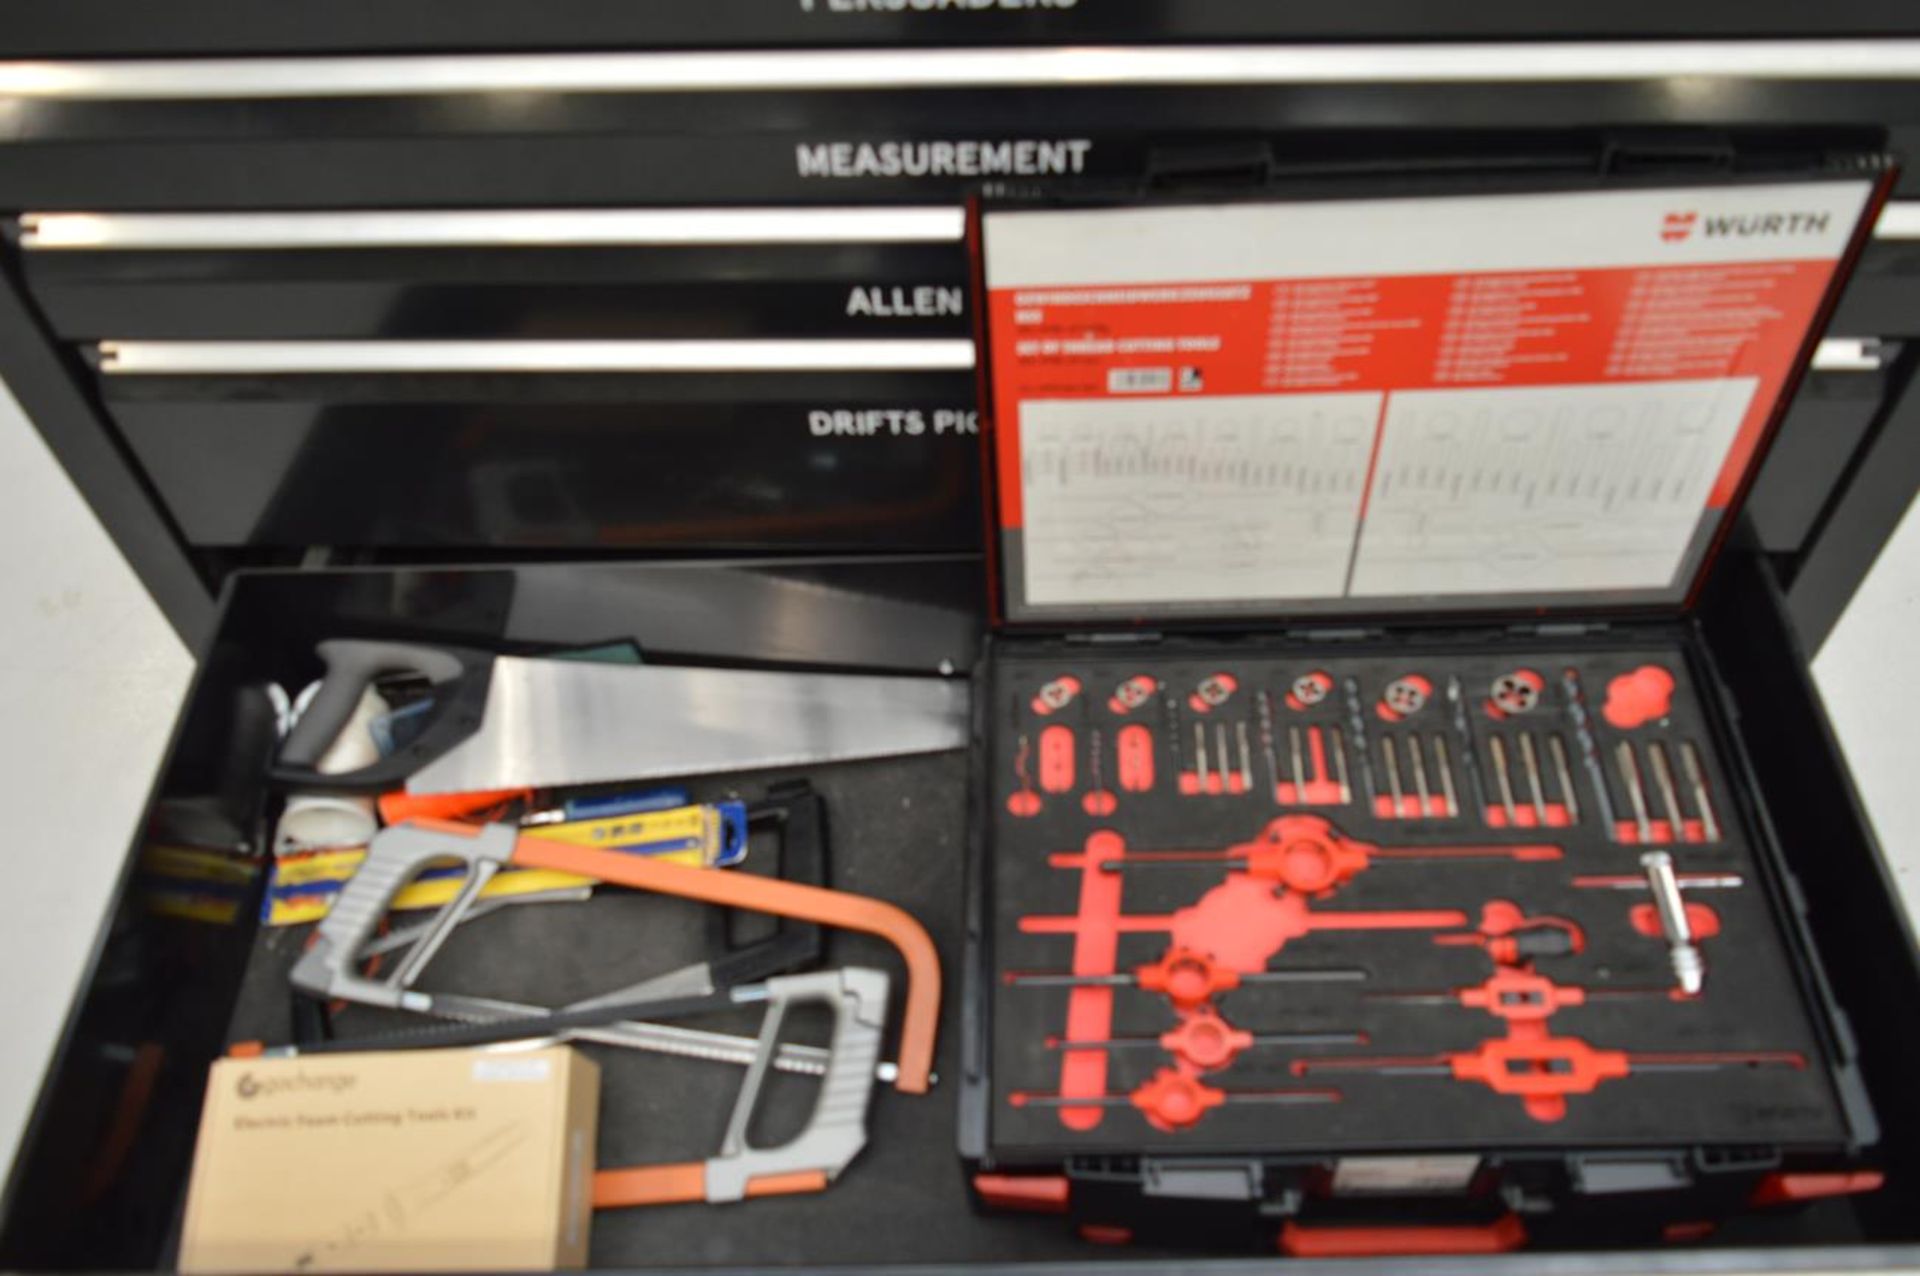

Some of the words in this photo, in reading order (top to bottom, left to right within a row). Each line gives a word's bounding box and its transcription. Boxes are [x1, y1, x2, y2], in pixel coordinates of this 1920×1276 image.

[796, 139, 1092, 177] MEASUREMENT
[846, 286, 963, 316] ALLEN
[808, 409, 925, 436] DRIFTS
